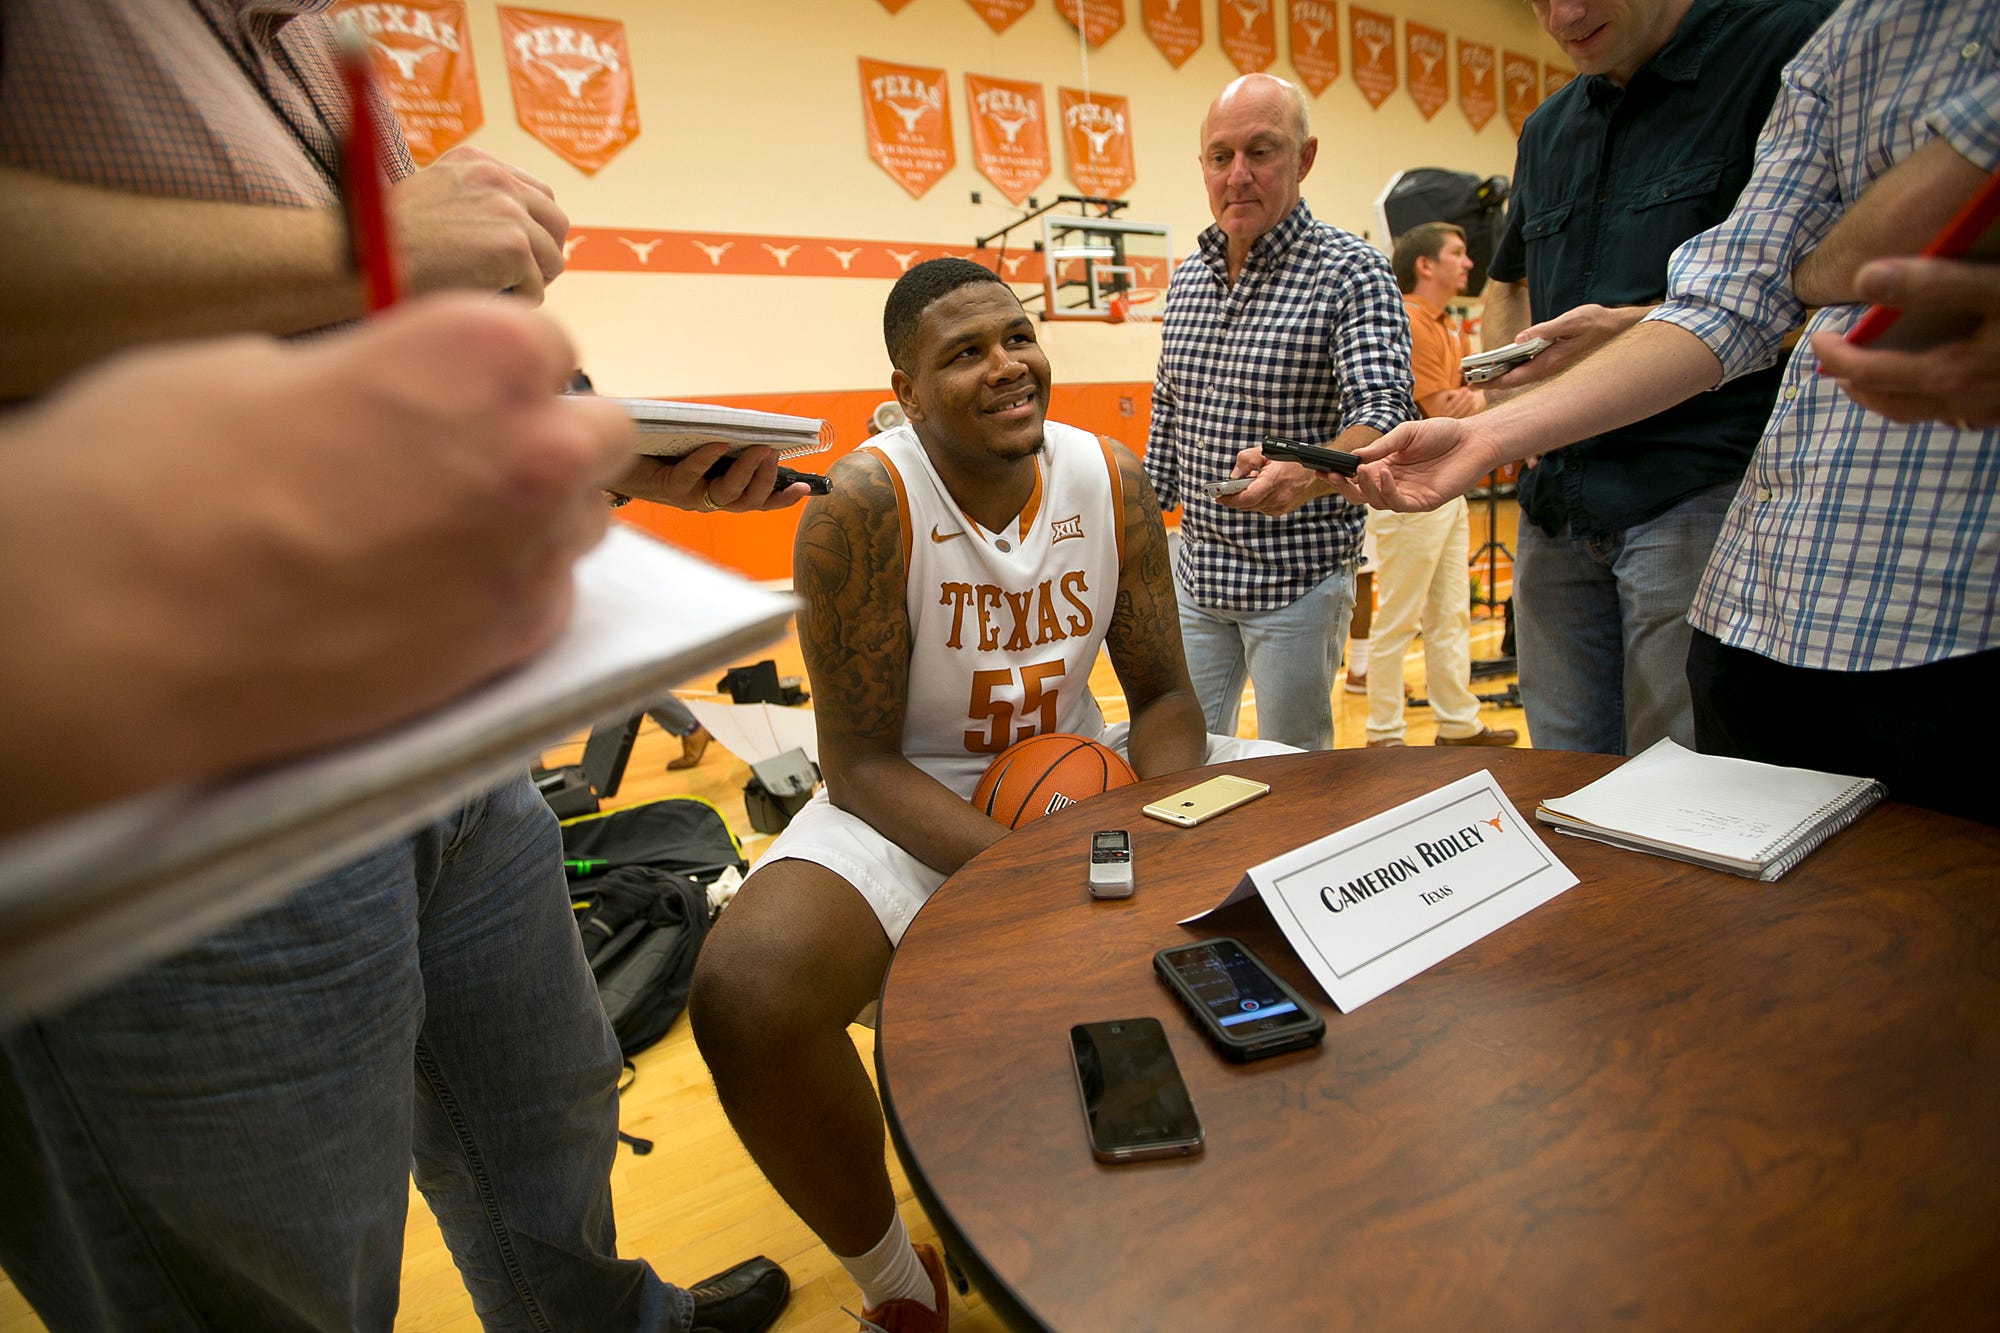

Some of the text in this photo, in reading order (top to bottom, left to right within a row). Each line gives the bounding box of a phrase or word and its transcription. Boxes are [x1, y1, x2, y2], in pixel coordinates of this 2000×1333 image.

[513, 26, 619, 73] TEXAS
[871, 74, 942, 111] TEXAS
[976, 88, 1038, 123] TEXAS
[1065, 102, 1125, 136] TEXAS
[938, 570, 1094, 652] TEXAS
[963, 658, 1067, 754] 55
[1320, 823, 1485, 914] CAMERON RIDLEY
[1418, 884, 1454, 907] TEXAS
